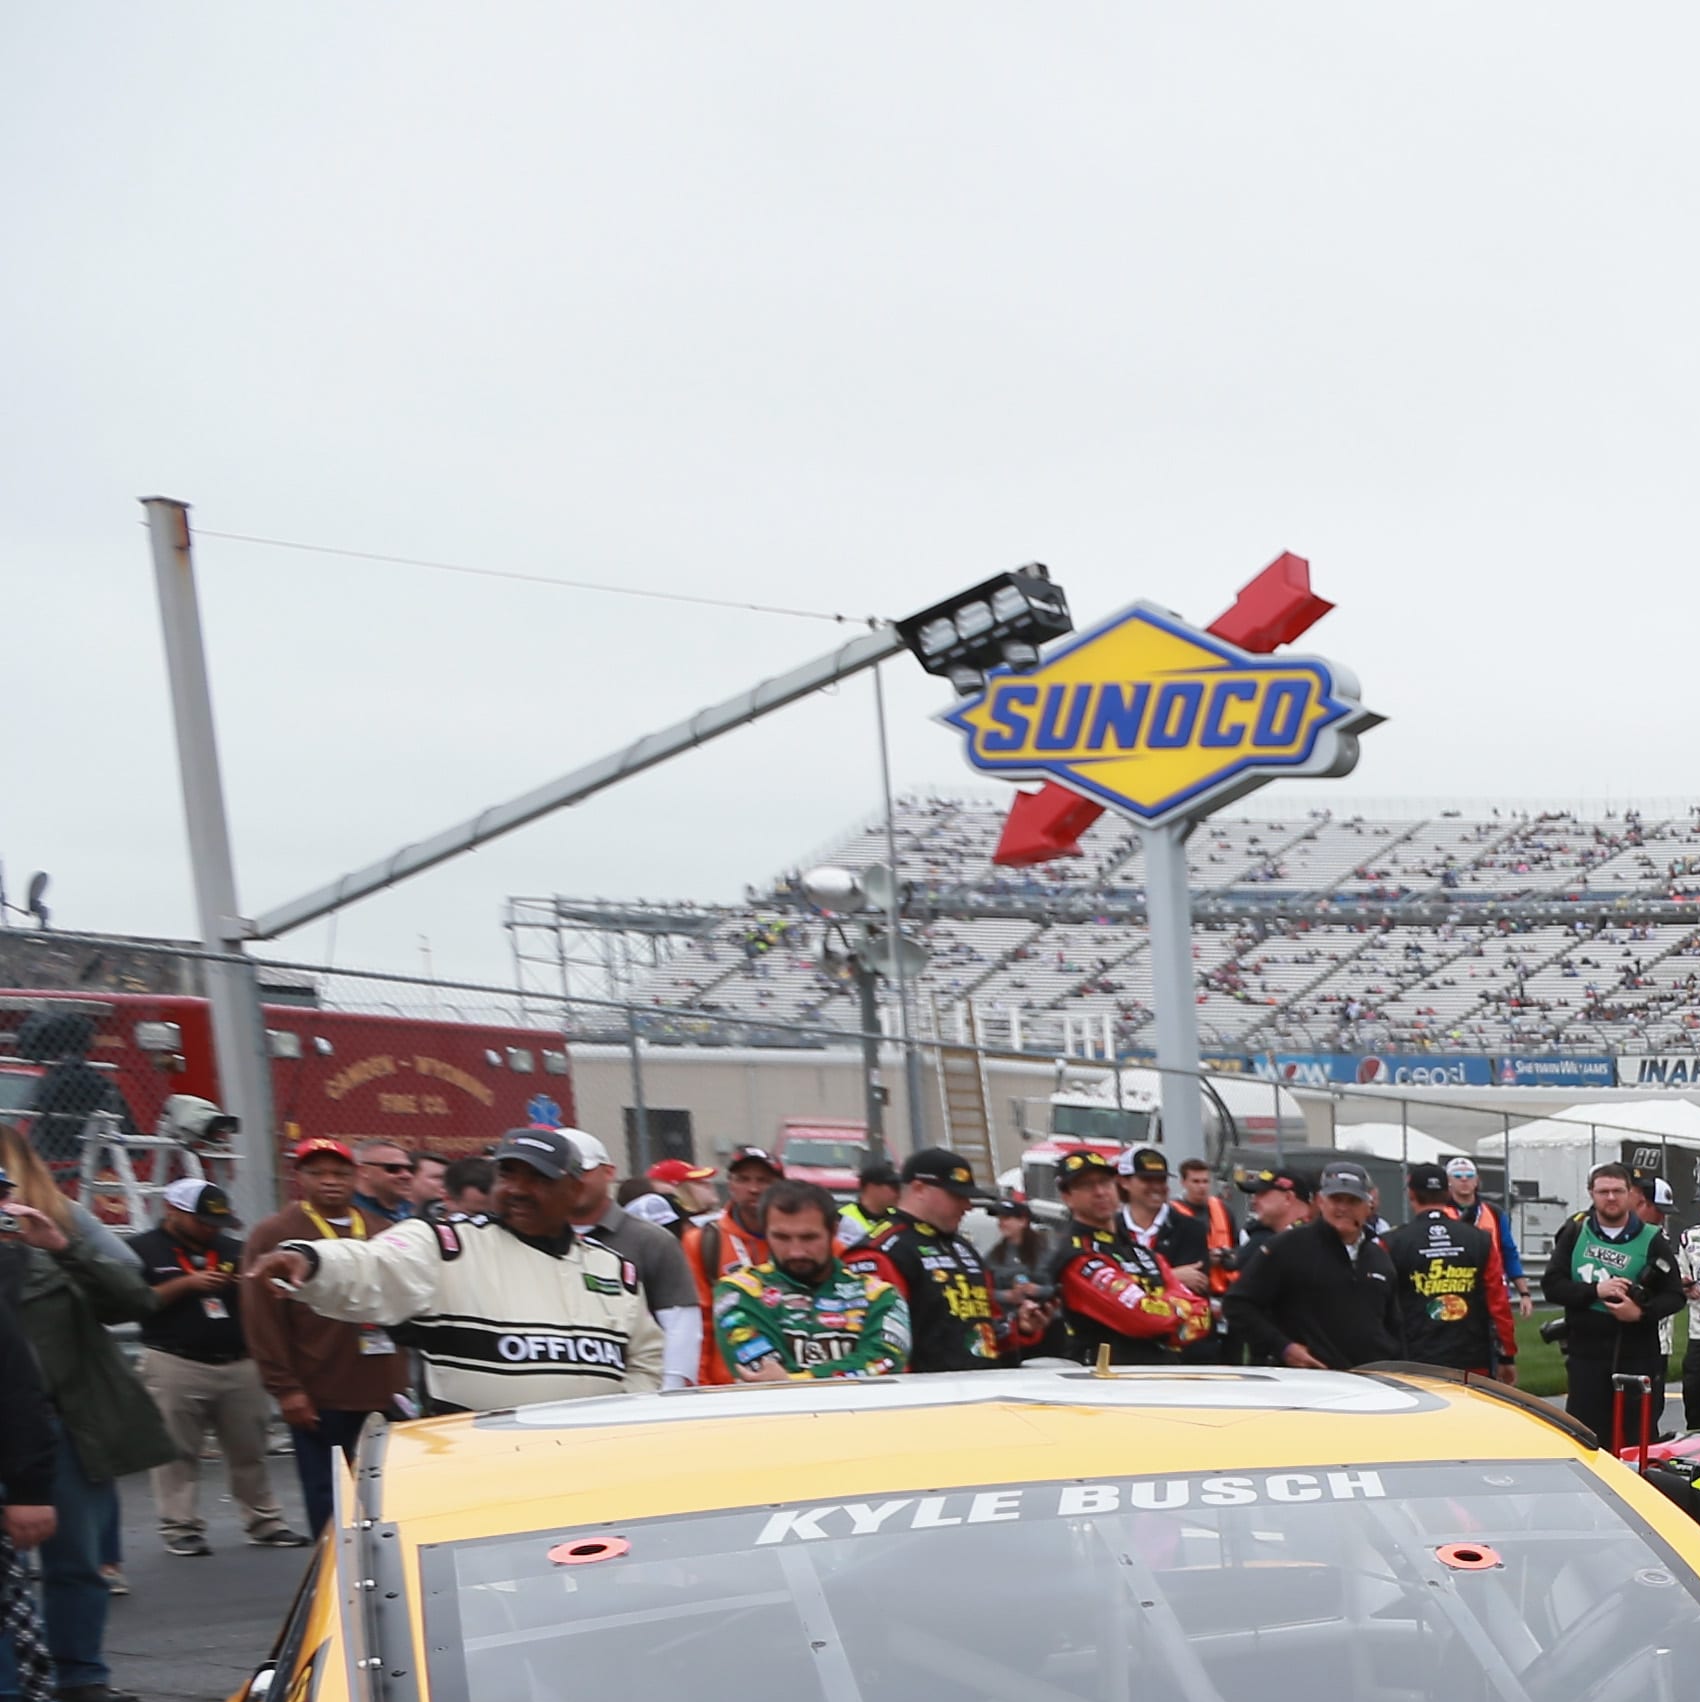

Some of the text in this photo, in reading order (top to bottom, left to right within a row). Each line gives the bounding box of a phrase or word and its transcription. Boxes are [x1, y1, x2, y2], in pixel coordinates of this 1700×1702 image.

[982, 679, 1313, 752] SUNOCO
[754, 1469, 1388, 1546] KYLE BUSCH
